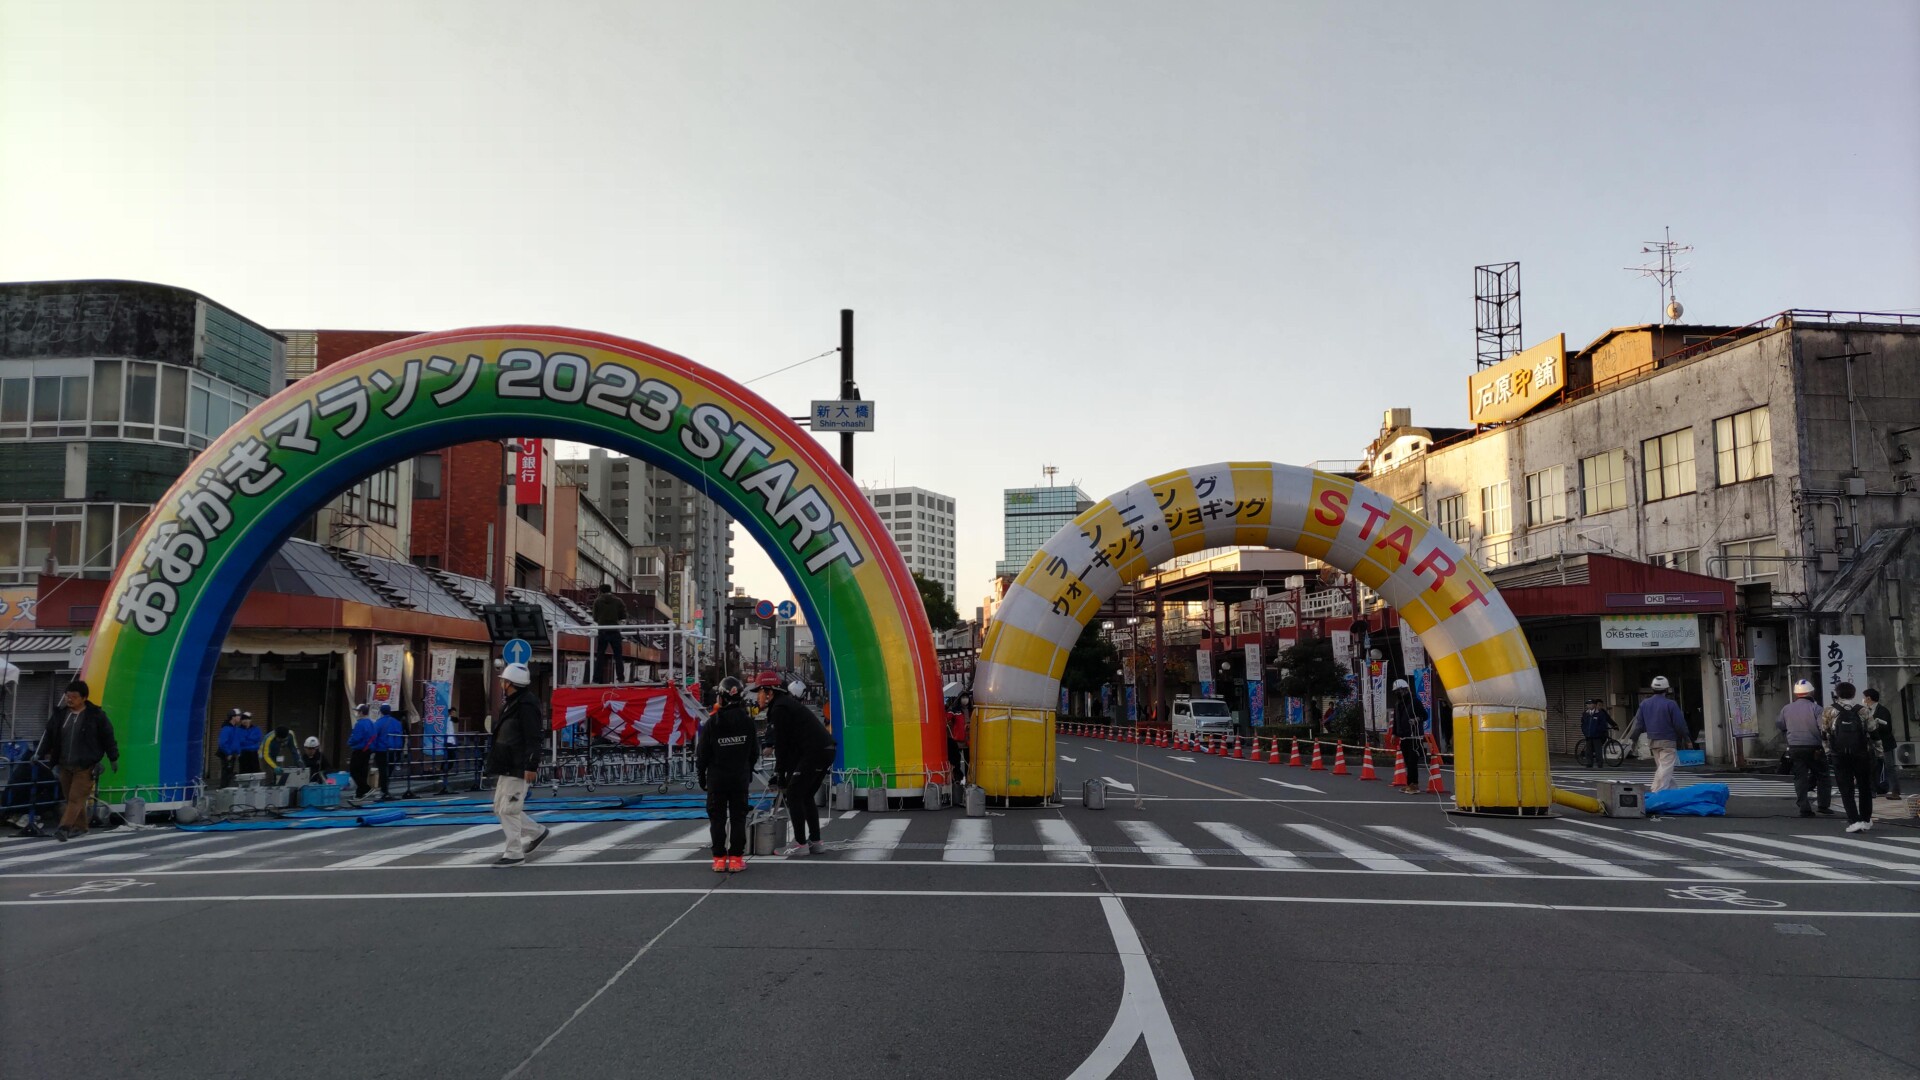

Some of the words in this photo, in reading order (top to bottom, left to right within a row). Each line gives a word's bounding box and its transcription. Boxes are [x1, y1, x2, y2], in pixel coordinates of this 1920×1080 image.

[817, 405, 869, 418] 新大橋
[1475, 356, 1557, 415] 石原印舗
[819, 420, 866, 428] Shin-ohashi
[116, 354, 483, 636] おおがきマラソン
[496, 349, 682, 433] 2023
[678, 404, 865, 575] START
[1046, 476, 1217, 579] ランニング
[1052, 497, 1267, 617] ウォーキング・ジョギング
[1314, 490, 1489, 615] START
[1605, 631, 1624, 639] OKB
[1625, 631, 1649, 639] street
[718, 735, 747, 744] CONNECT
